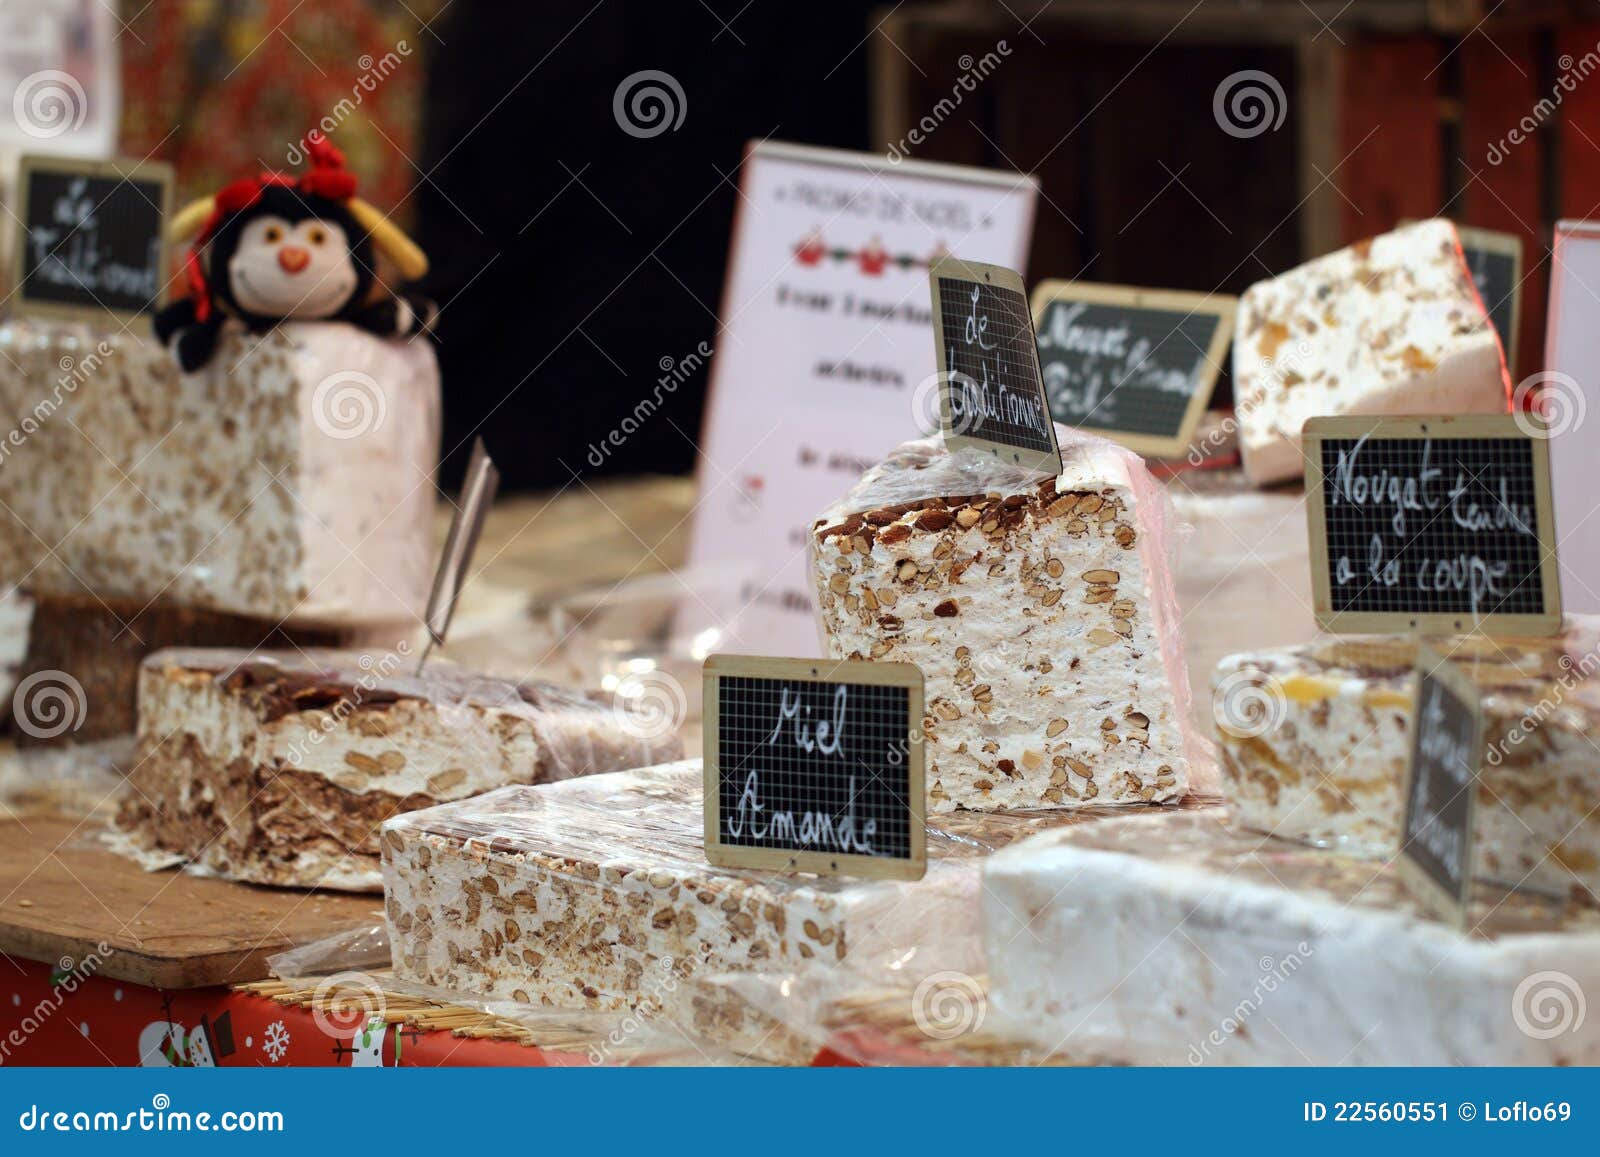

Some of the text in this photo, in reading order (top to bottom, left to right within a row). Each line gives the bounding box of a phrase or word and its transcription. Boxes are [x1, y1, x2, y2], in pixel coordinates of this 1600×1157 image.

[1332, 434, 1442, 537] Nougat
[1369, 533, 1400, 586] la
[1417, 554, 1508, 625] coupe
[769, 685, 847, 759] Miel
[728, 768, 880, 856] Amande
